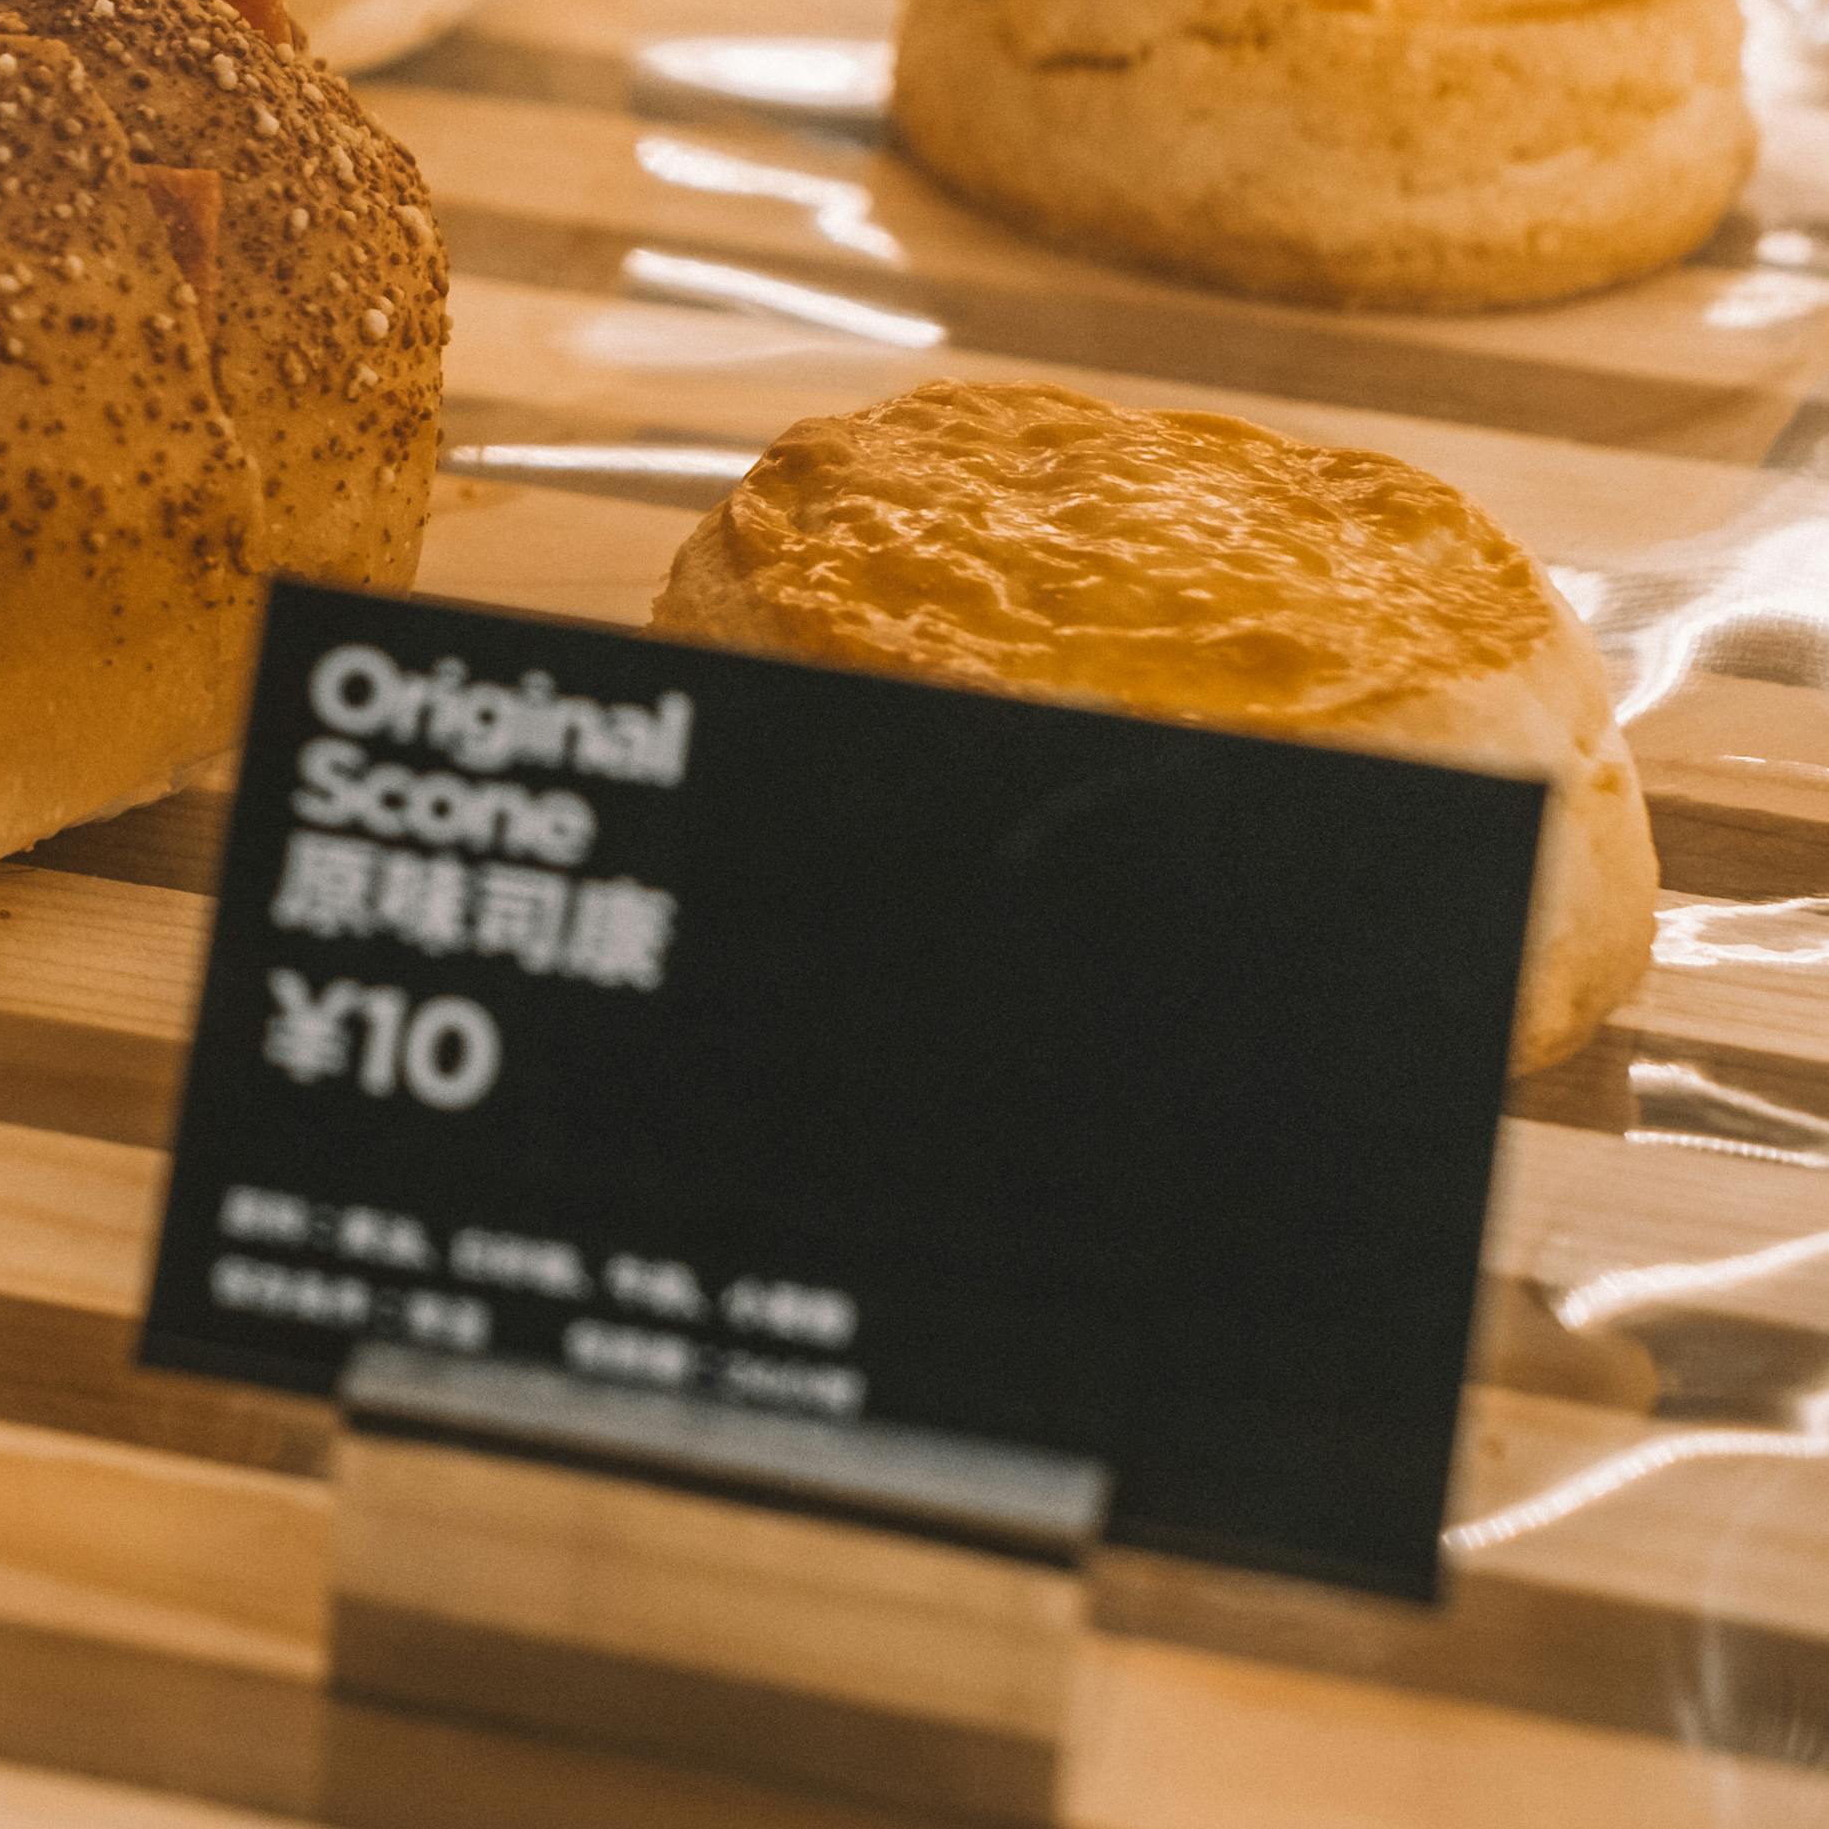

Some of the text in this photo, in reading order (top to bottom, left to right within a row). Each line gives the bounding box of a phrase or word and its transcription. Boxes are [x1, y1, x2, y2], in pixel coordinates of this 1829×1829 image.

[312, 647, 691, 785] Original
[297, 740, 594, 863] Scone
[275, 833, 673, 987] 原味司康
[269, 971, 499, 1107] ¥10
